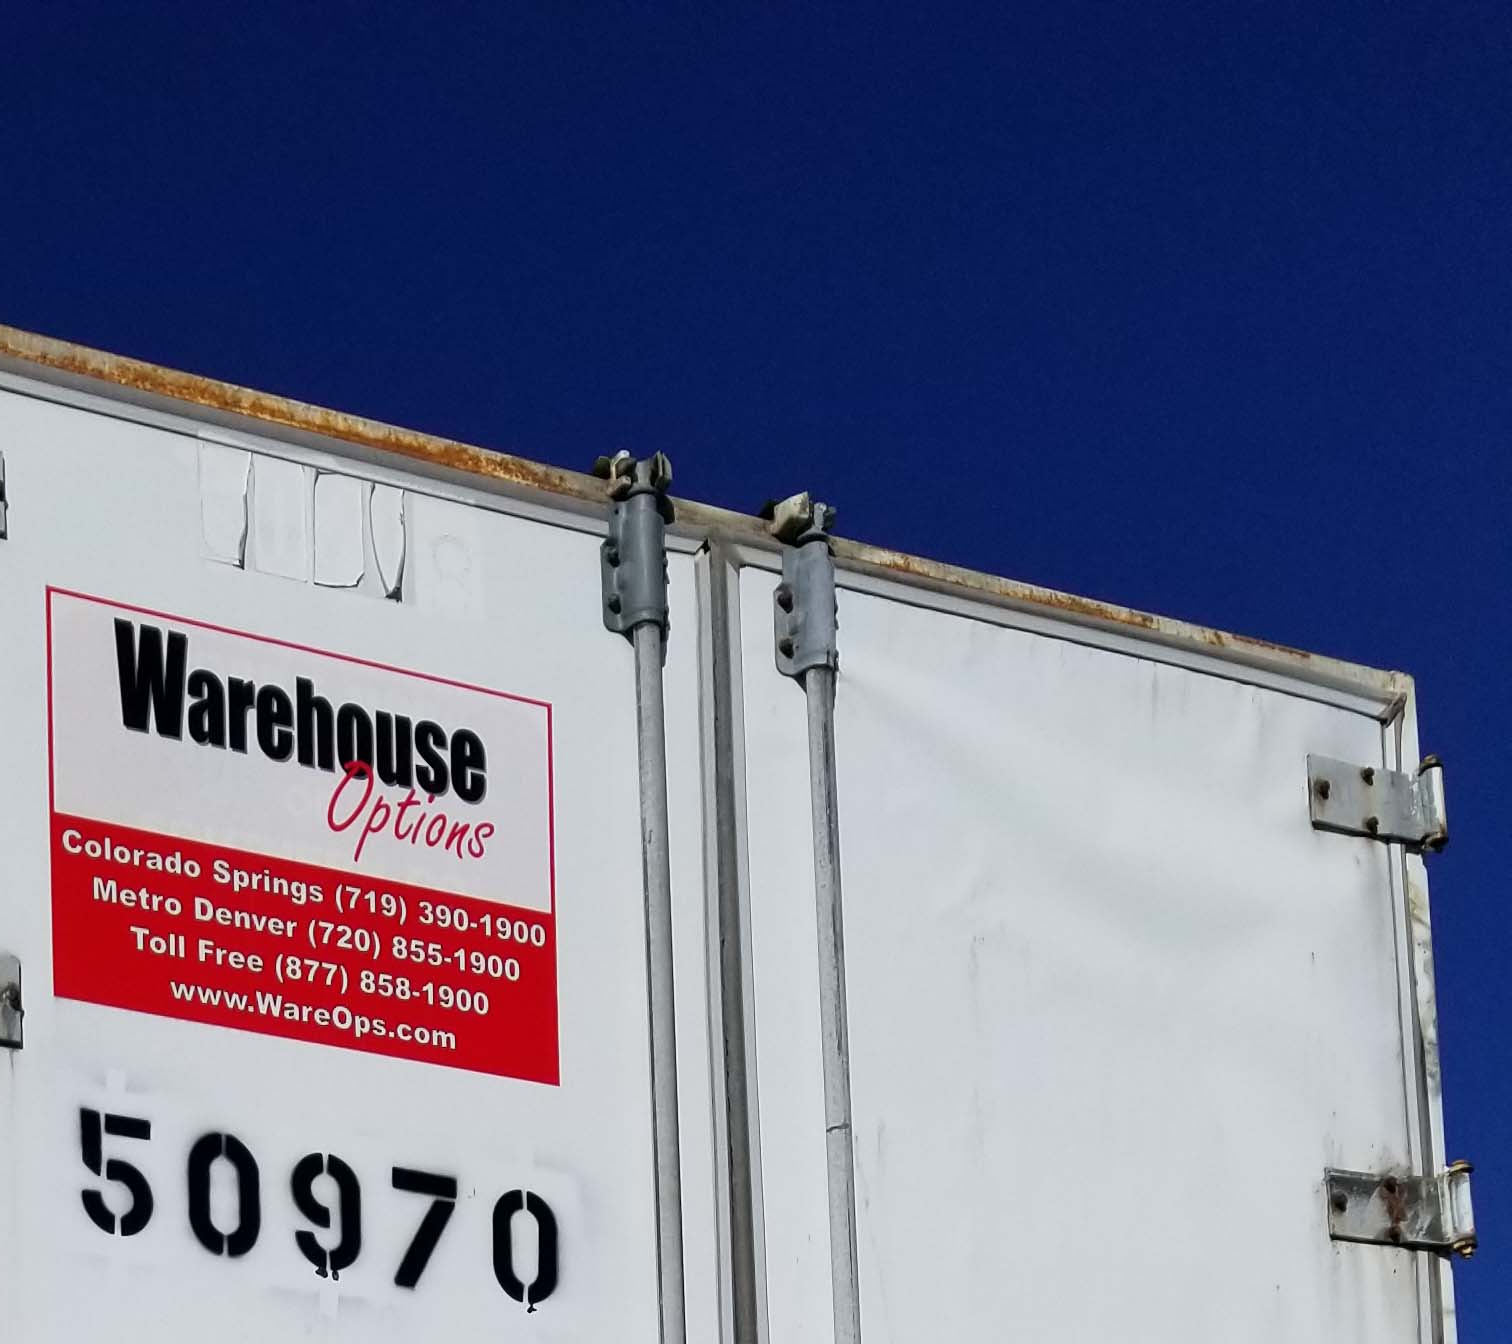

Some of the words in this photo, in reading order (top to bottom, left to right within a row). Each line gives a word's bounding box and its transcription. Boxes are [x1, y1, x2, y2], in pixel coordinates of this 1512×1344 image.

[114, 617, 487, 805] Warehouse
[327, 761, 495, 863] Options
[62, 829, 201, 878] Colorado
[213, 859, 324, 905] Springs
[335, 884, 407, 926] (719)
[419, 901, 546, 947] 390-1900
[92, 877, 182, 915] Metro
[194, 897, 297, 938] Denver
[308, 919, 381, 960] (720)
[392, 936, 520, 981] 855-1900
[130, 926, 186, 958] Toll
[198, 939, 264, 973] Free
[275, 954, 348, 995] (877)
[360, 970, 489, 1015] 858-1900
[170, 981, 457, 1050] www.WareOps.com
[79, 1106, 559, 1305] 50970
